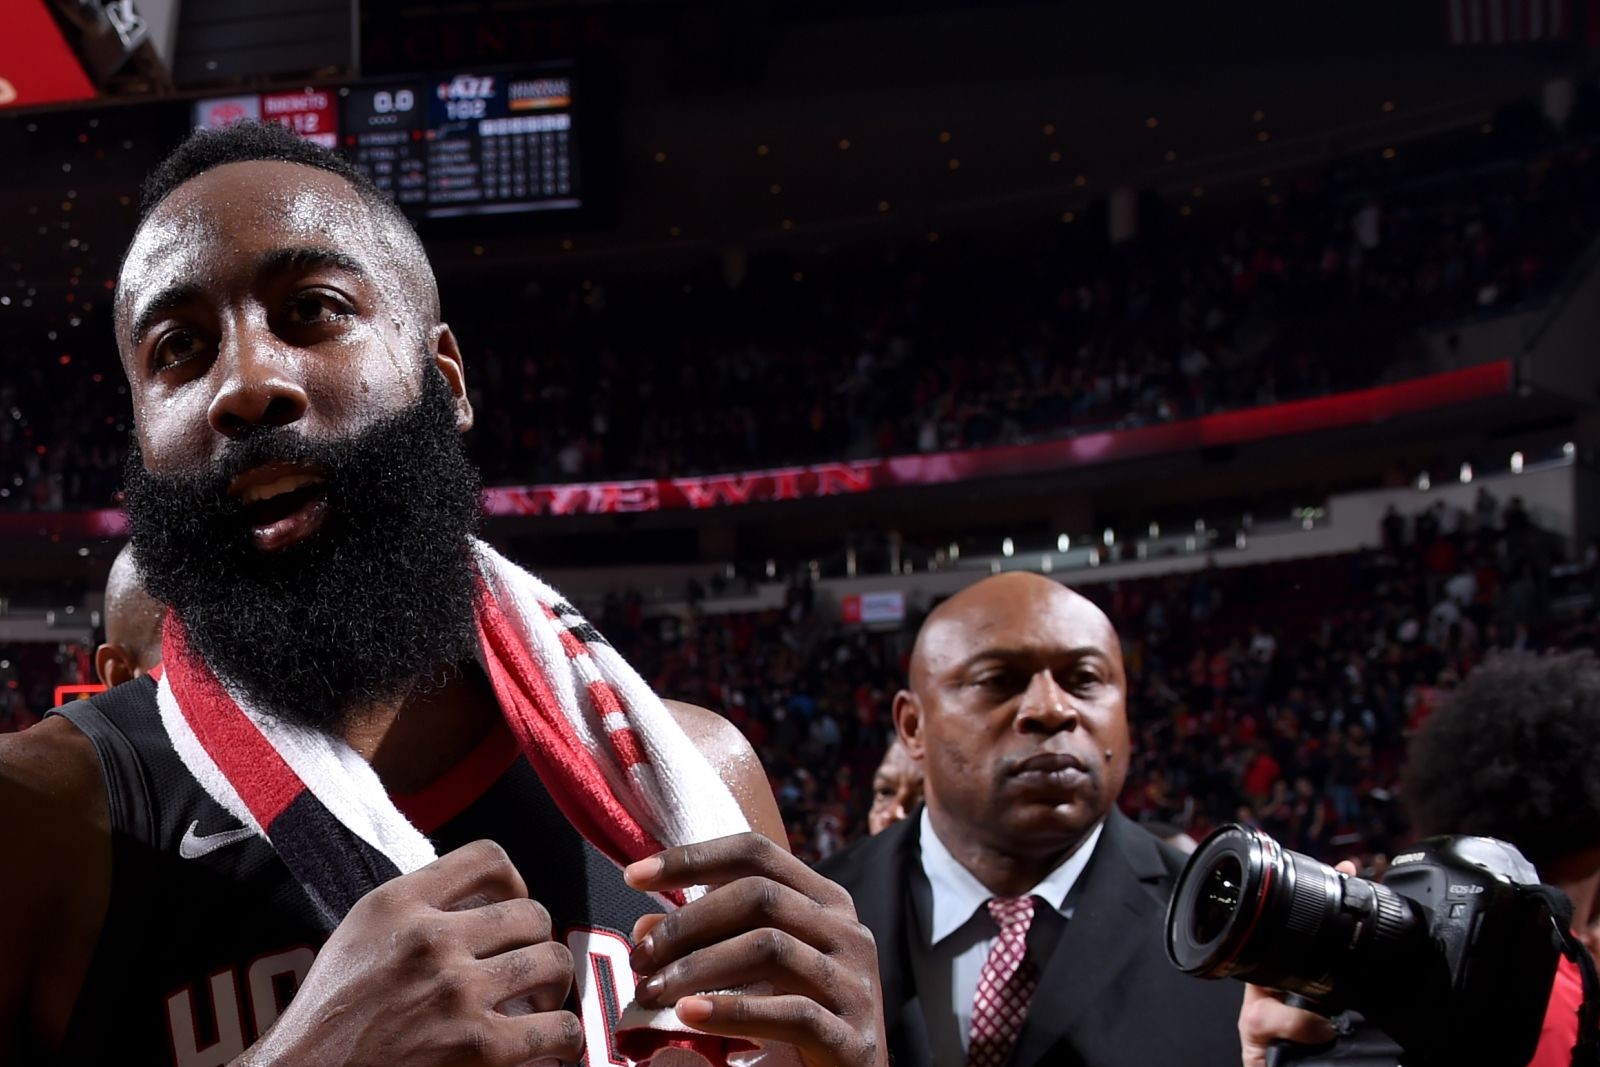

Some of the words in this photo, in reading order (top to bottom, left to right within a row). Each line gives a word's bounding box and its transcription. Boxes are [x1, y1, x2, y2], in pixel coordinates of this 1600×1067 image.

[373, 90, 414, 114] 0.0
[672, 459, 882, 509] WIN
[1391, 852, 1426, 866] Canon
